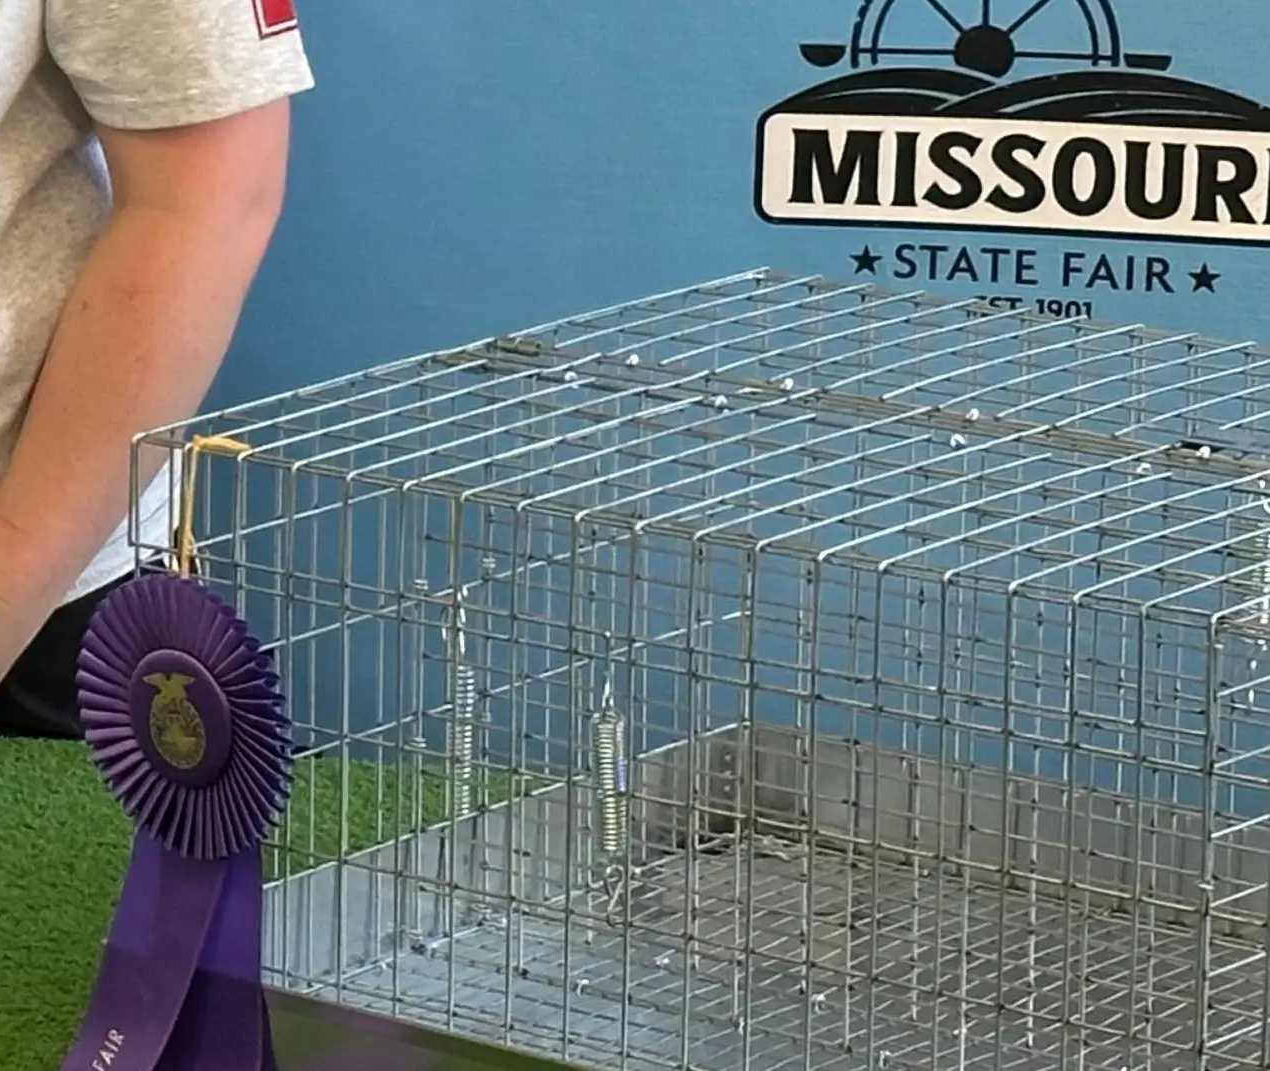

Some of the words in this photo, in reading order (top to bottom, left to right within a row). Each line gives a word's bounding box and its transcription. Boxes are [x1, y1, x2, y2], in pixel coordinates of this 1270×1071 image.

[788, 128, 1270, 224] MISSOUR
[893, 244, 1037, 285] STATE
[1062, 251, 1176, 294] FAIR
[91, 1028, 125, 1071] FAIR
